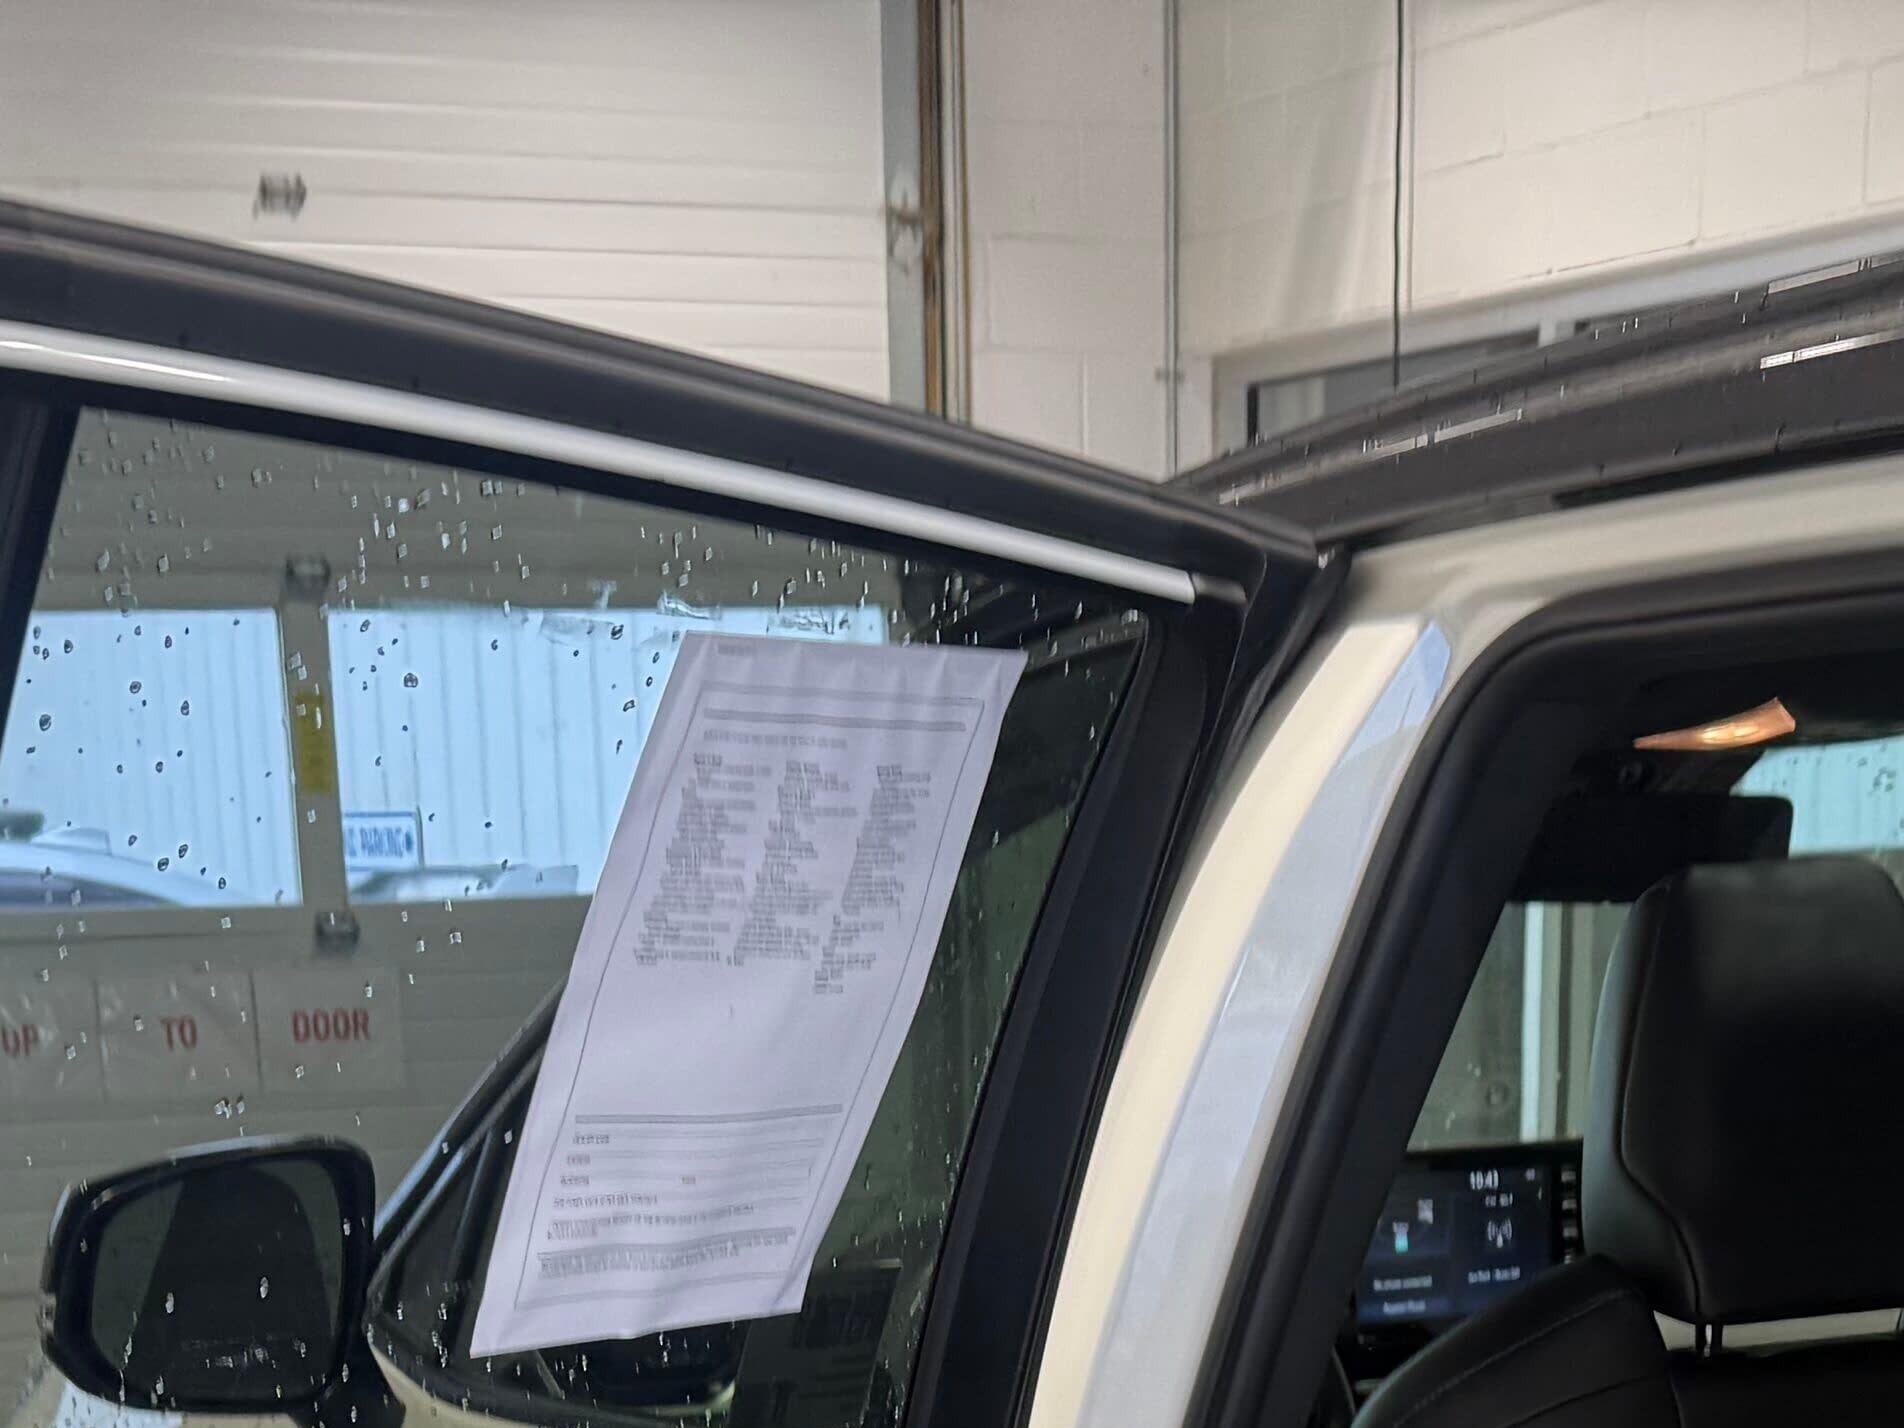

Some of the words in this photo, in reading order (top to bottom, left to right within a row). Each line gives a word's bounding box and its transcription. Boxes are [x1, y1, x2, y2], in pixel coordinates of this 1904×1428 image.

[1, 1023, 39, 1057] UP
[159, 1014, 198, 1051] TO
[291, 1007, 371, 1043] DOOR
